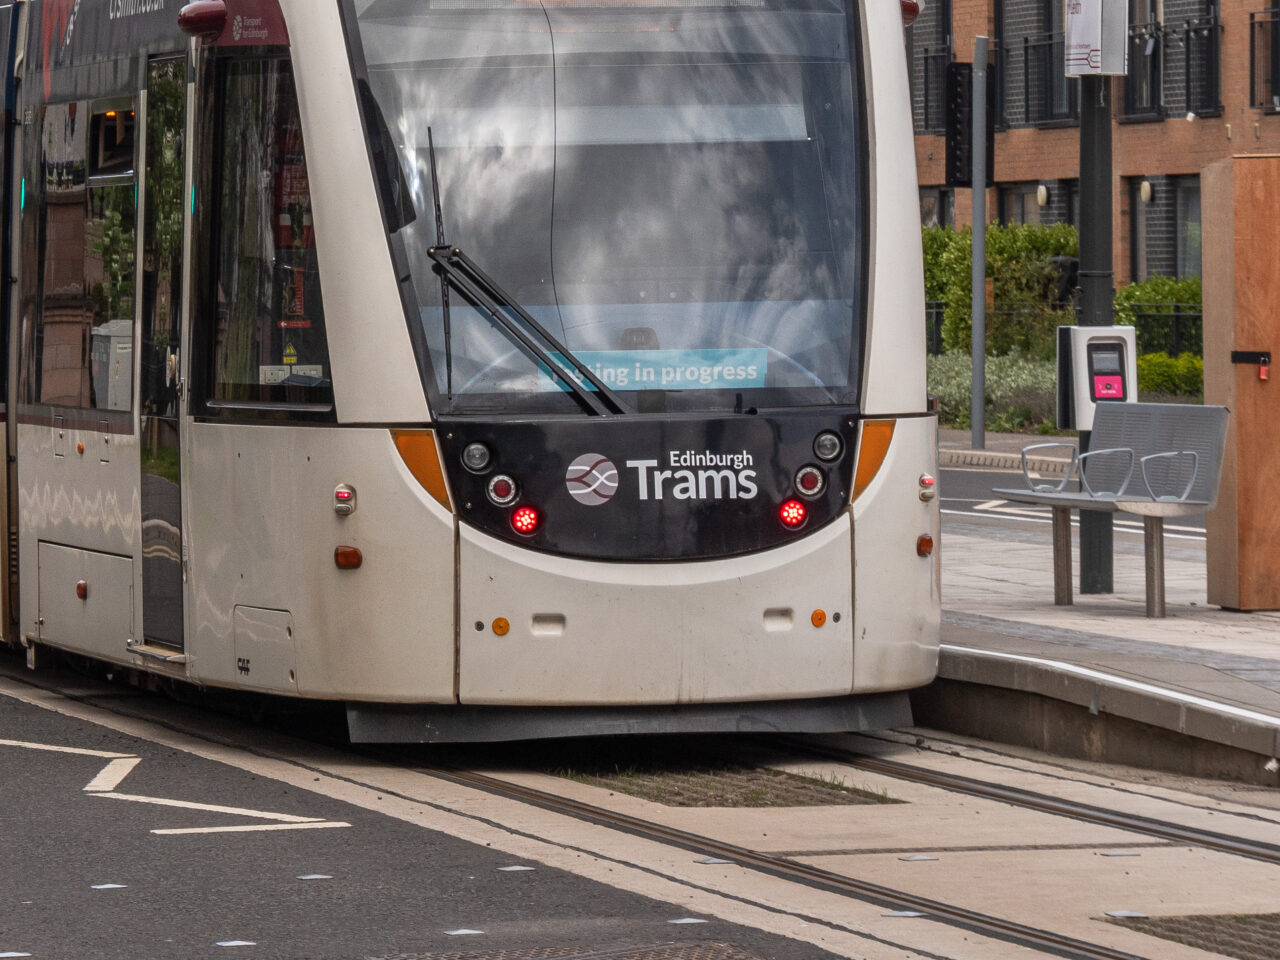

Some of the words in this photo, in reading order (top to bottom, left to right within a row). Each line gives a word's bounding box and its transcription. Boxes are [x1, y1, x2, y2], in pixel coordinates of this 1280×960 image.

[635, 362, 655, 381] in
[661, 363, 758, 385] progress
[669, 450, 753, 470] Edinburgh
[626, 459, 758, 501] Trams
